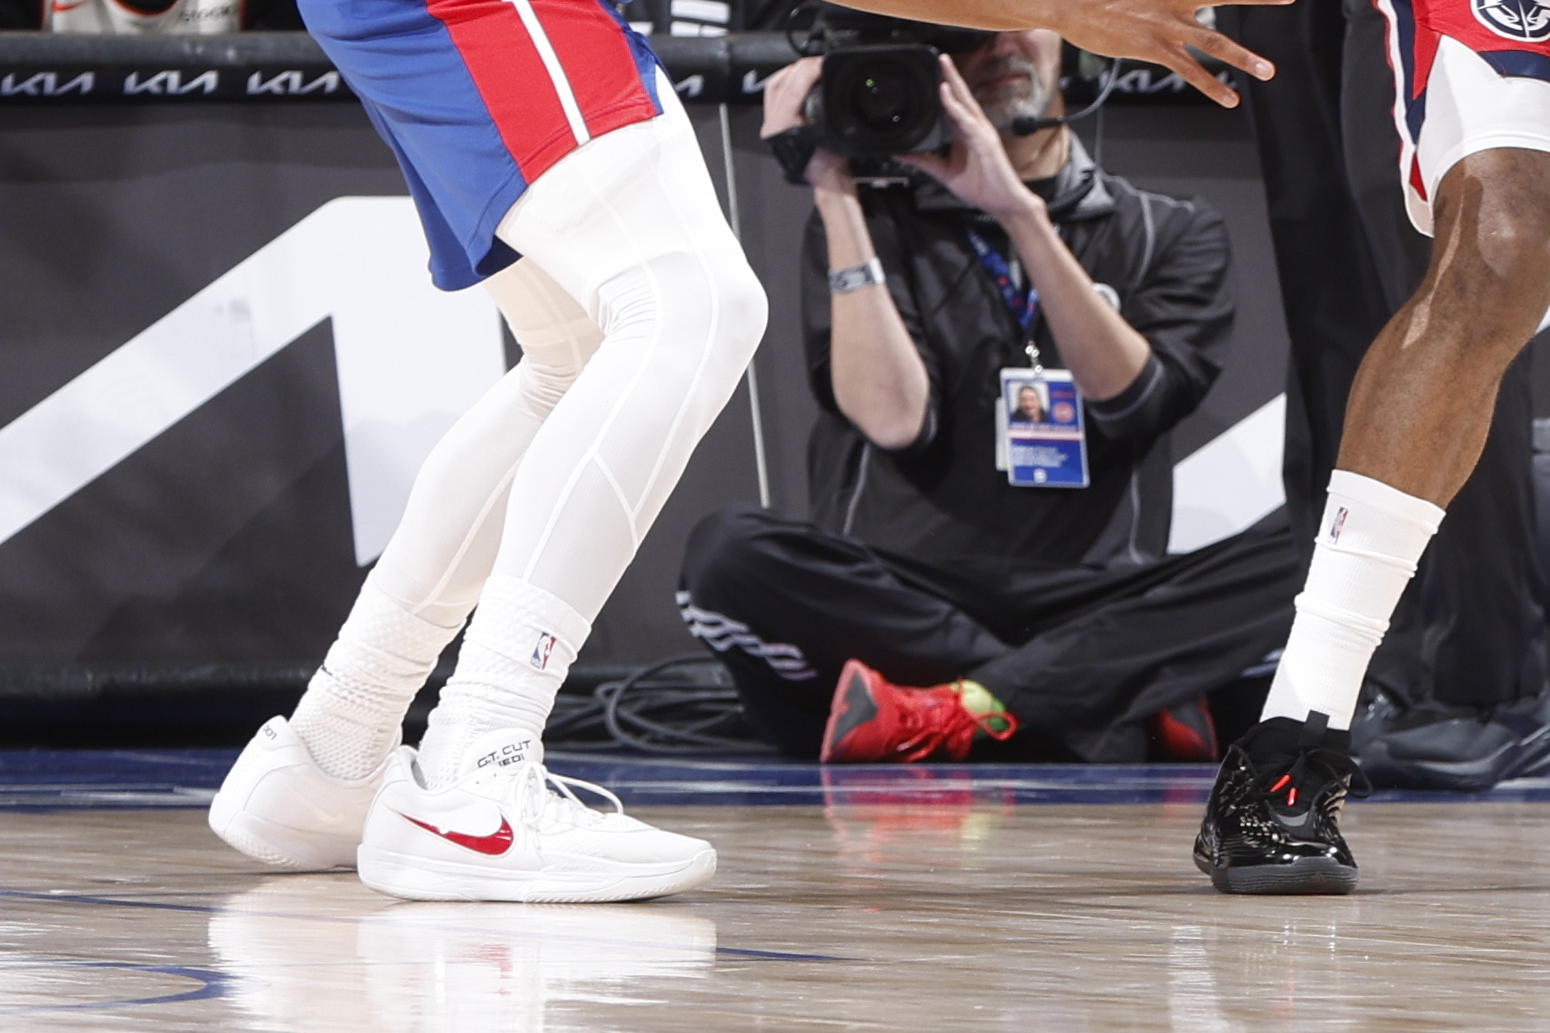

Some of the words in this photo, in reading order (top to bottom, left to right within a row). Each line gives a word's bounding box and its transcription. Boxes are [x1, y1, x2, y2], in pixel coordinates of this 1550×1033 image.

[1, 71, 96, 96] KIA
[123, 70, 220, 95] KIA
[246, 70, 341, 95] KIA
[502, 739, 532, 755] CUT
